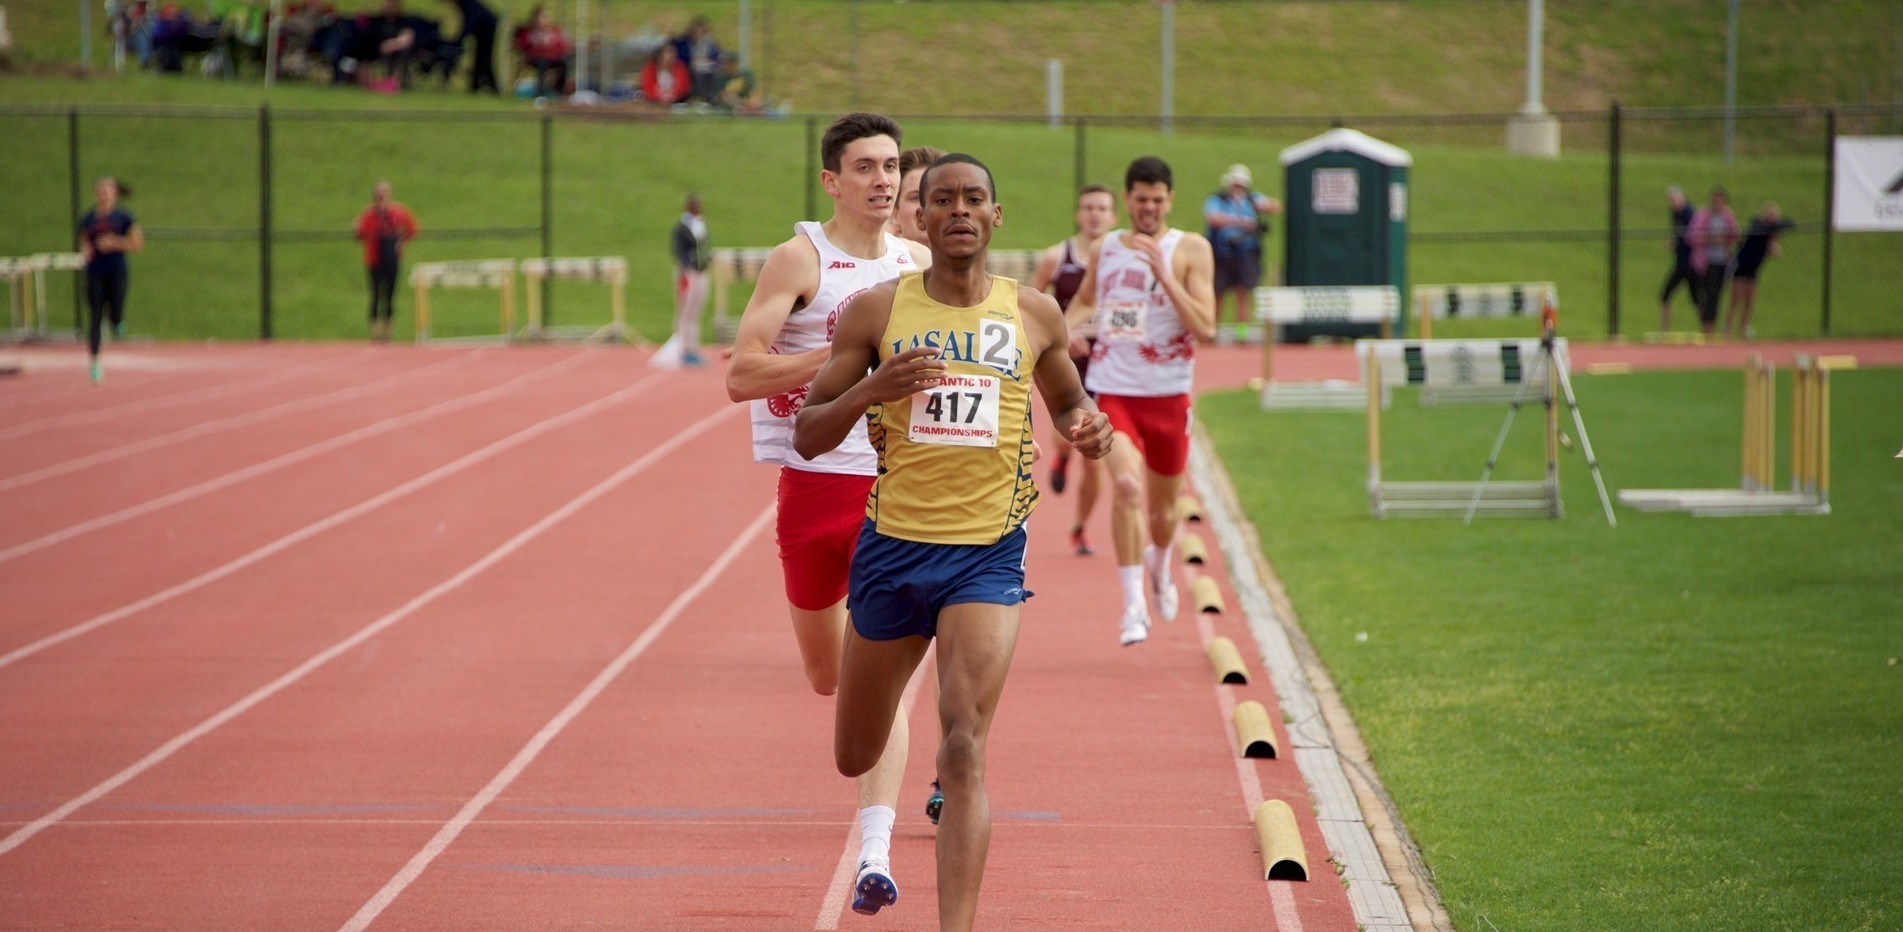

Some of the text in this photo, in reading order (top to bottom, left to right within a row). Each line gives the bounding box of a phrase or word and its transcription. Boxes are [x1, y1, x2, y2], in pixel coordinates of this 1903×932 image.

[828, 261, 856, 269] A10
[983, 323, 1010, 366] 2
[979, 378, 992, 388] 10
[925, 391, 983, 424] 417
[912, 425, 993, 438] CHAMPIONSHIPS
